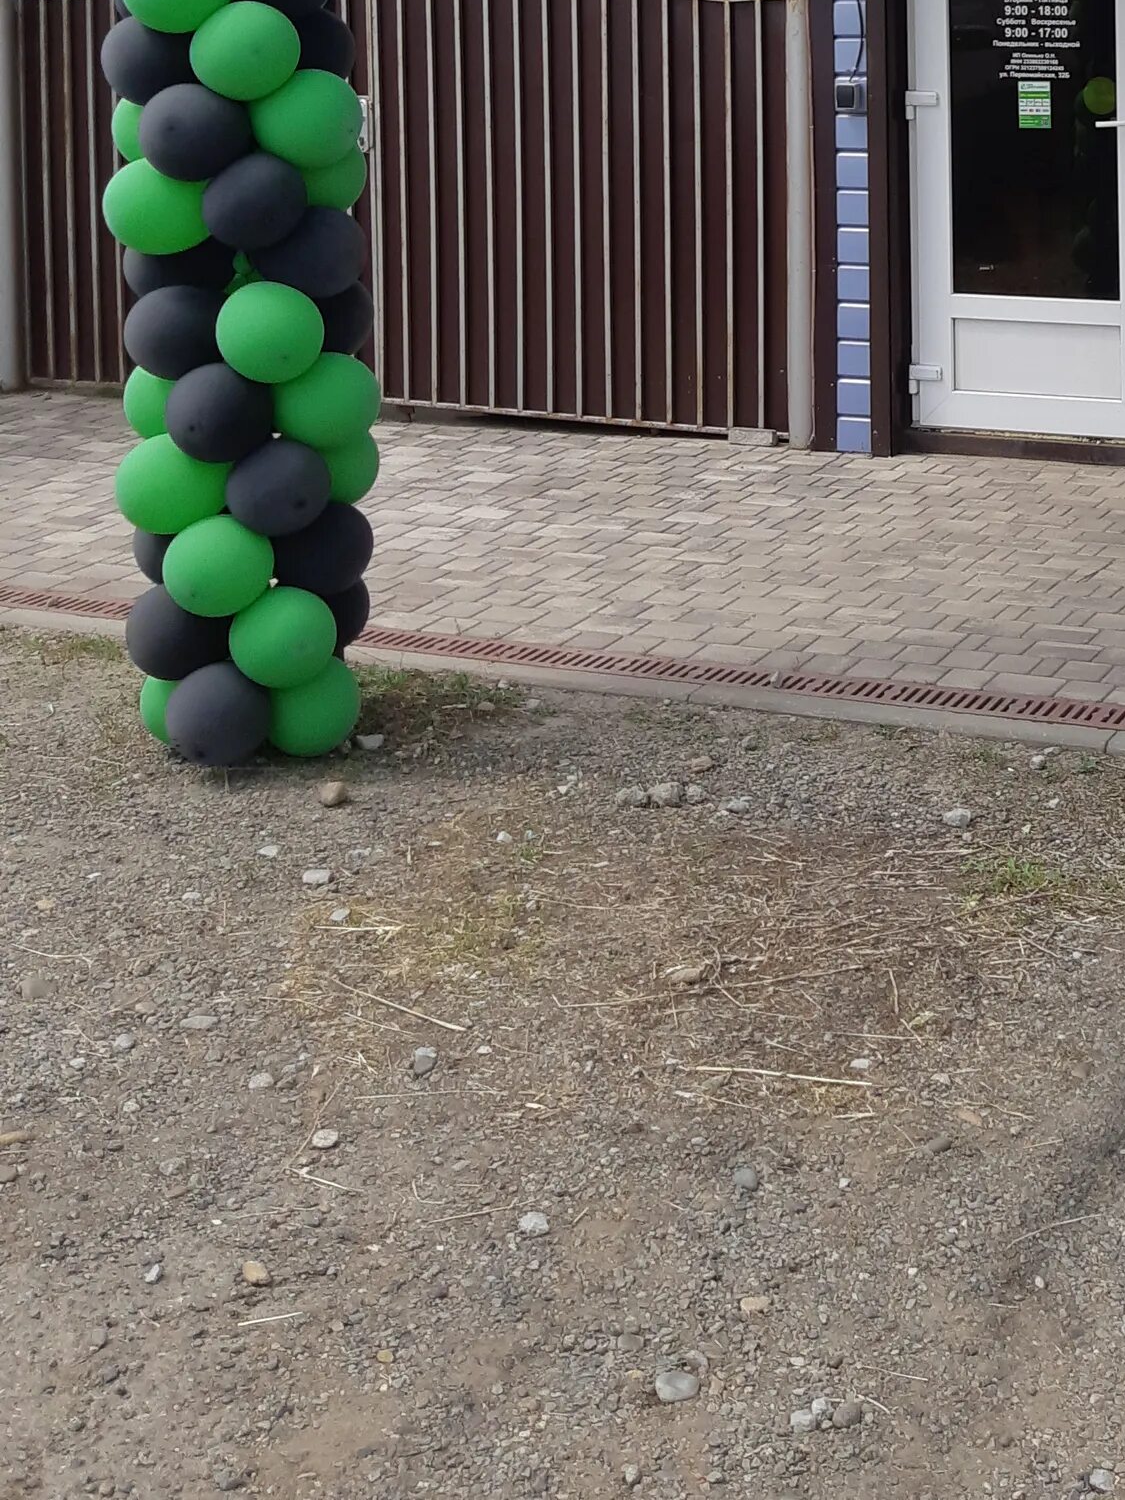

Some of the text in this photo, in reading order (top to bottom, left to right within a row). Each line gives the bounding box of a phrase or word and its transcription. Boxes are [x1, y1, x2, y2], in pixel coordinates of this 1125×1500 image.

[1004, 5, 1028, 16] 9:00
[1038, 5, 1068, 16] 18:00
[1004, 27, 1028, 38] 9:00
[1038, 27, 1068, 38] 17:00
